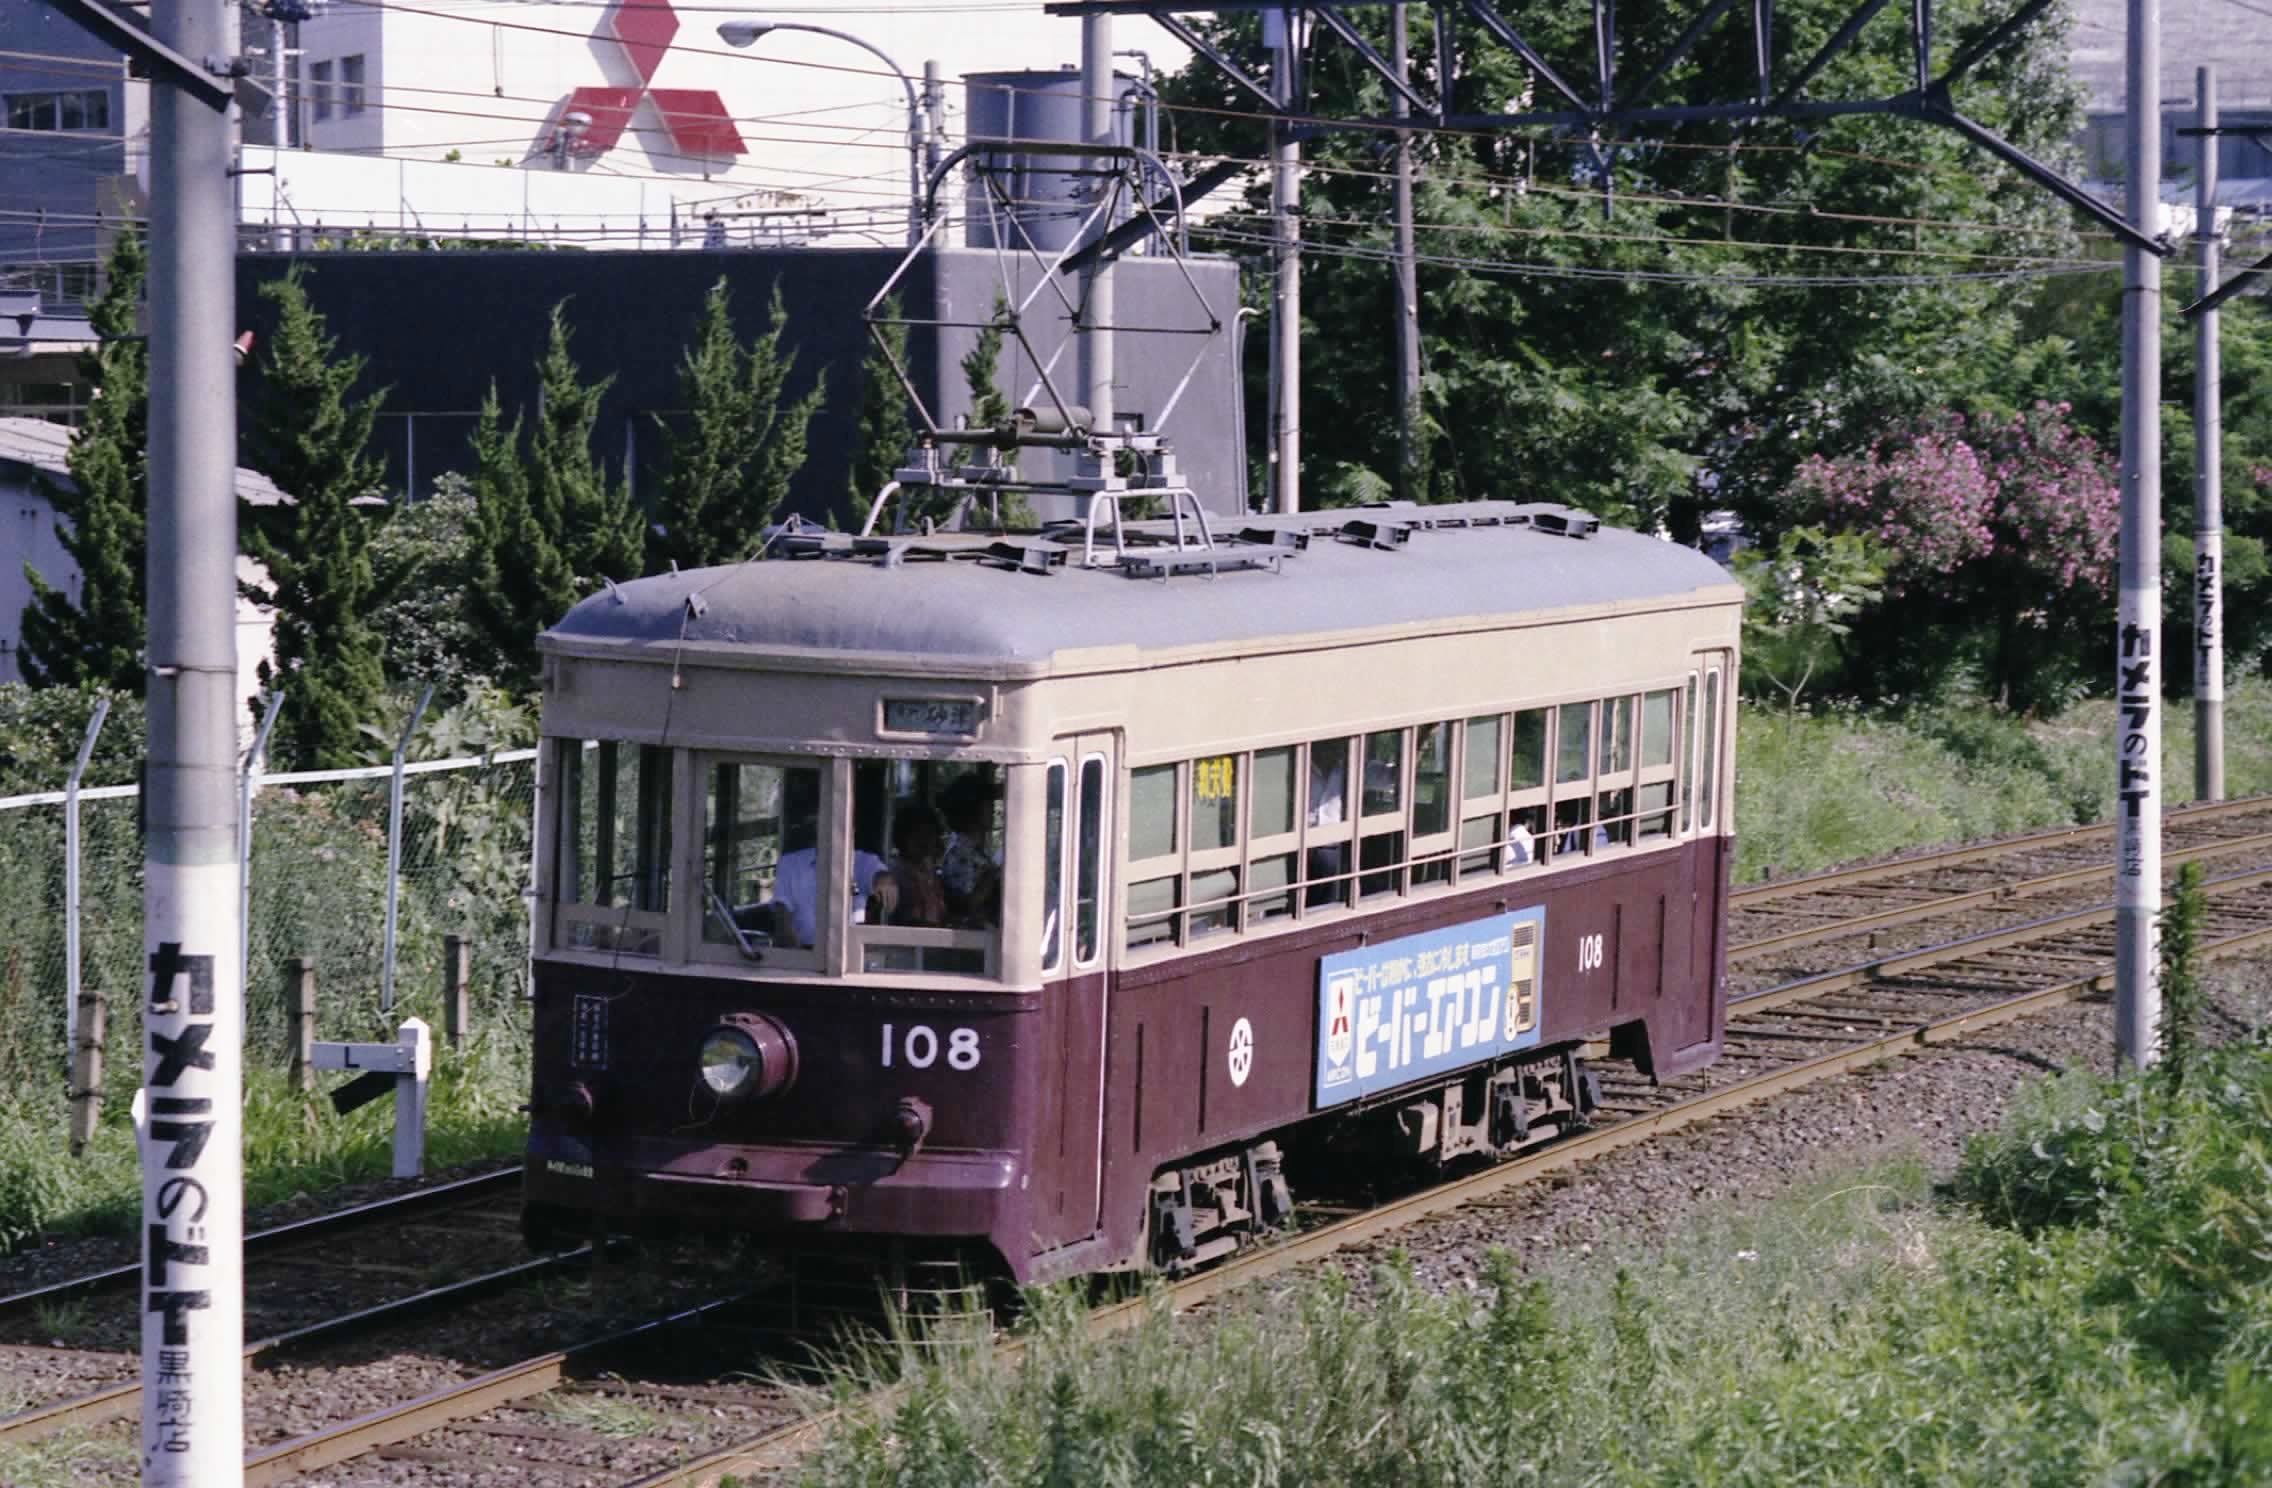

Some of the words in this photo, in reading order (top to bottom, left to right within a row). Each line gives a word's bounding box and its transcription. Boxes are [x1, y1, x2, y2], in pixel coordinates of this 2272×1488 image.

[1578, 934, 1603, 973] 108
[1356, 965, 1501, 1079] ビーバーエアコン
[344, 1046, 361, 1068] L
[881, 1023, 982, 1071] 108
